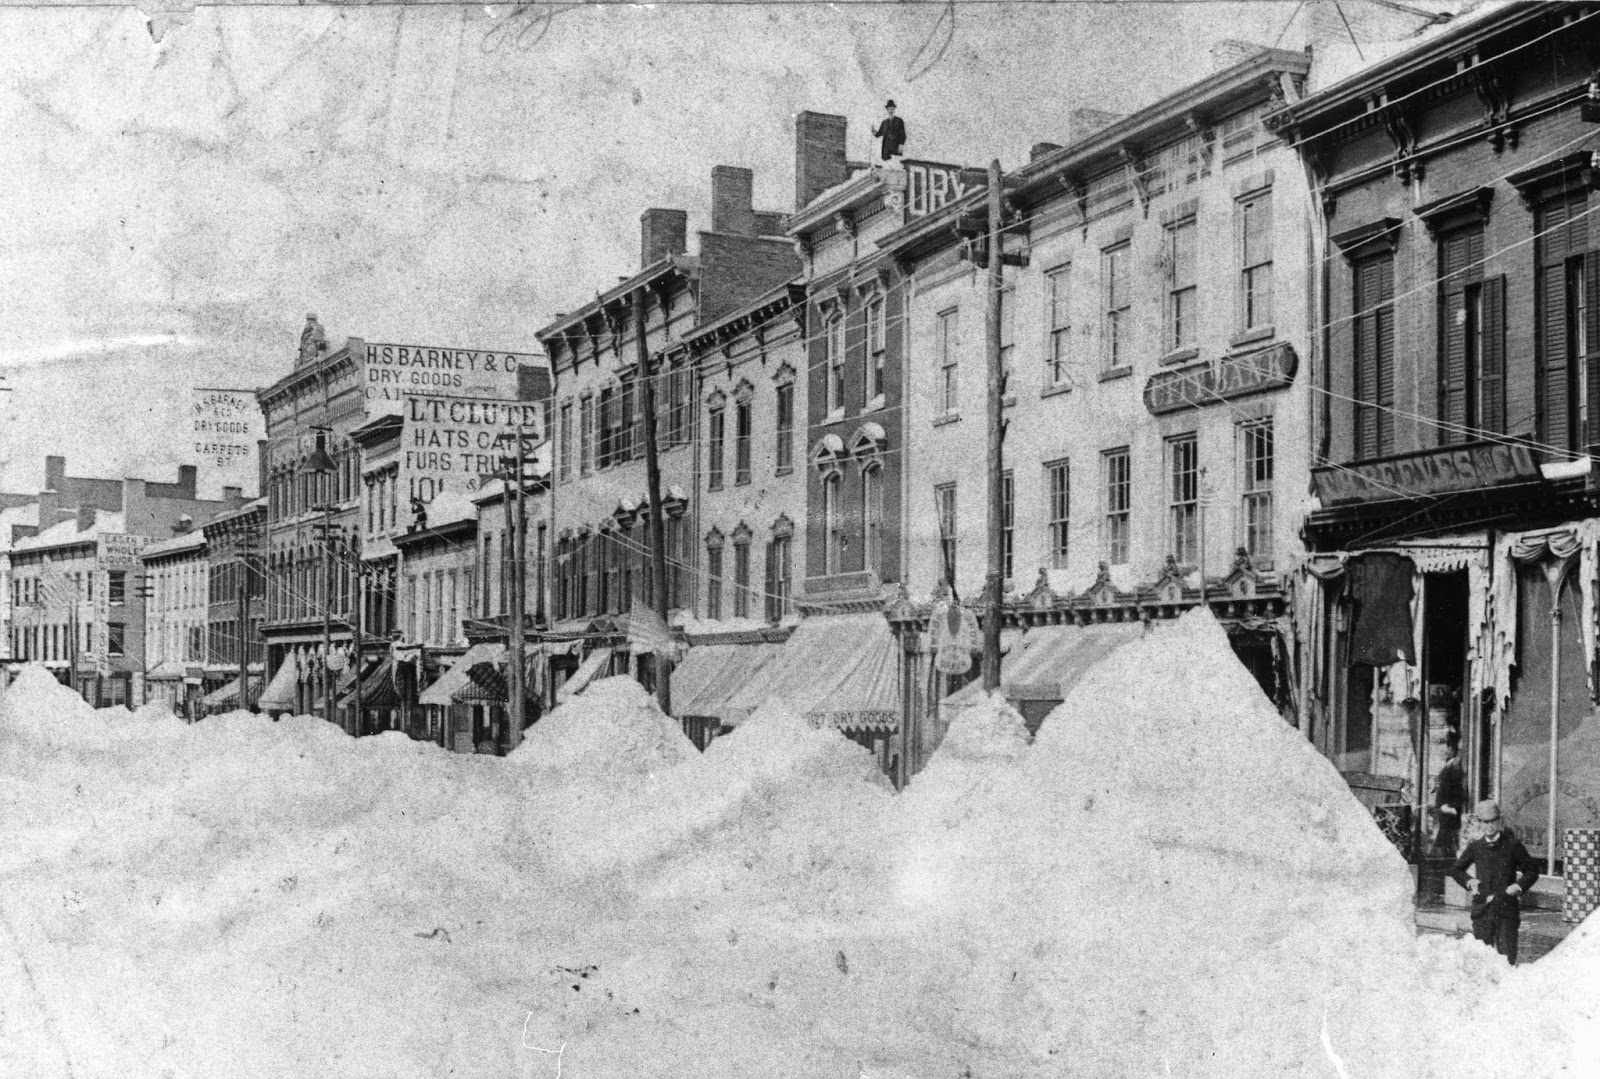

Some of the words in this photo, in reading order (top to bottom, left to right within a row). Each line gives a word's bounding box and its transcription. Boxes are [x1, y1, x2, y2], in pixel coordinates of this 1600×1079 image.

[909, 165, 966, 216] DRY
[399, 347, 478, 370] BARNEY
[484, 354, 498, 372] &
[369, 368, 402, 384] DRY
[411, 371, 462, 387] GOODS
[449, 401, 536, 428] CLUTE
[215, 421, 249, 434] GOODS
[415, 428, 469, 448] HATS
[195, 442, 249, 455] CARPETS
[406, 450, 452, 471] FURS
[1357, 450, 1477, 496] REEVES
[860, 712, 895, 724] GOODS
